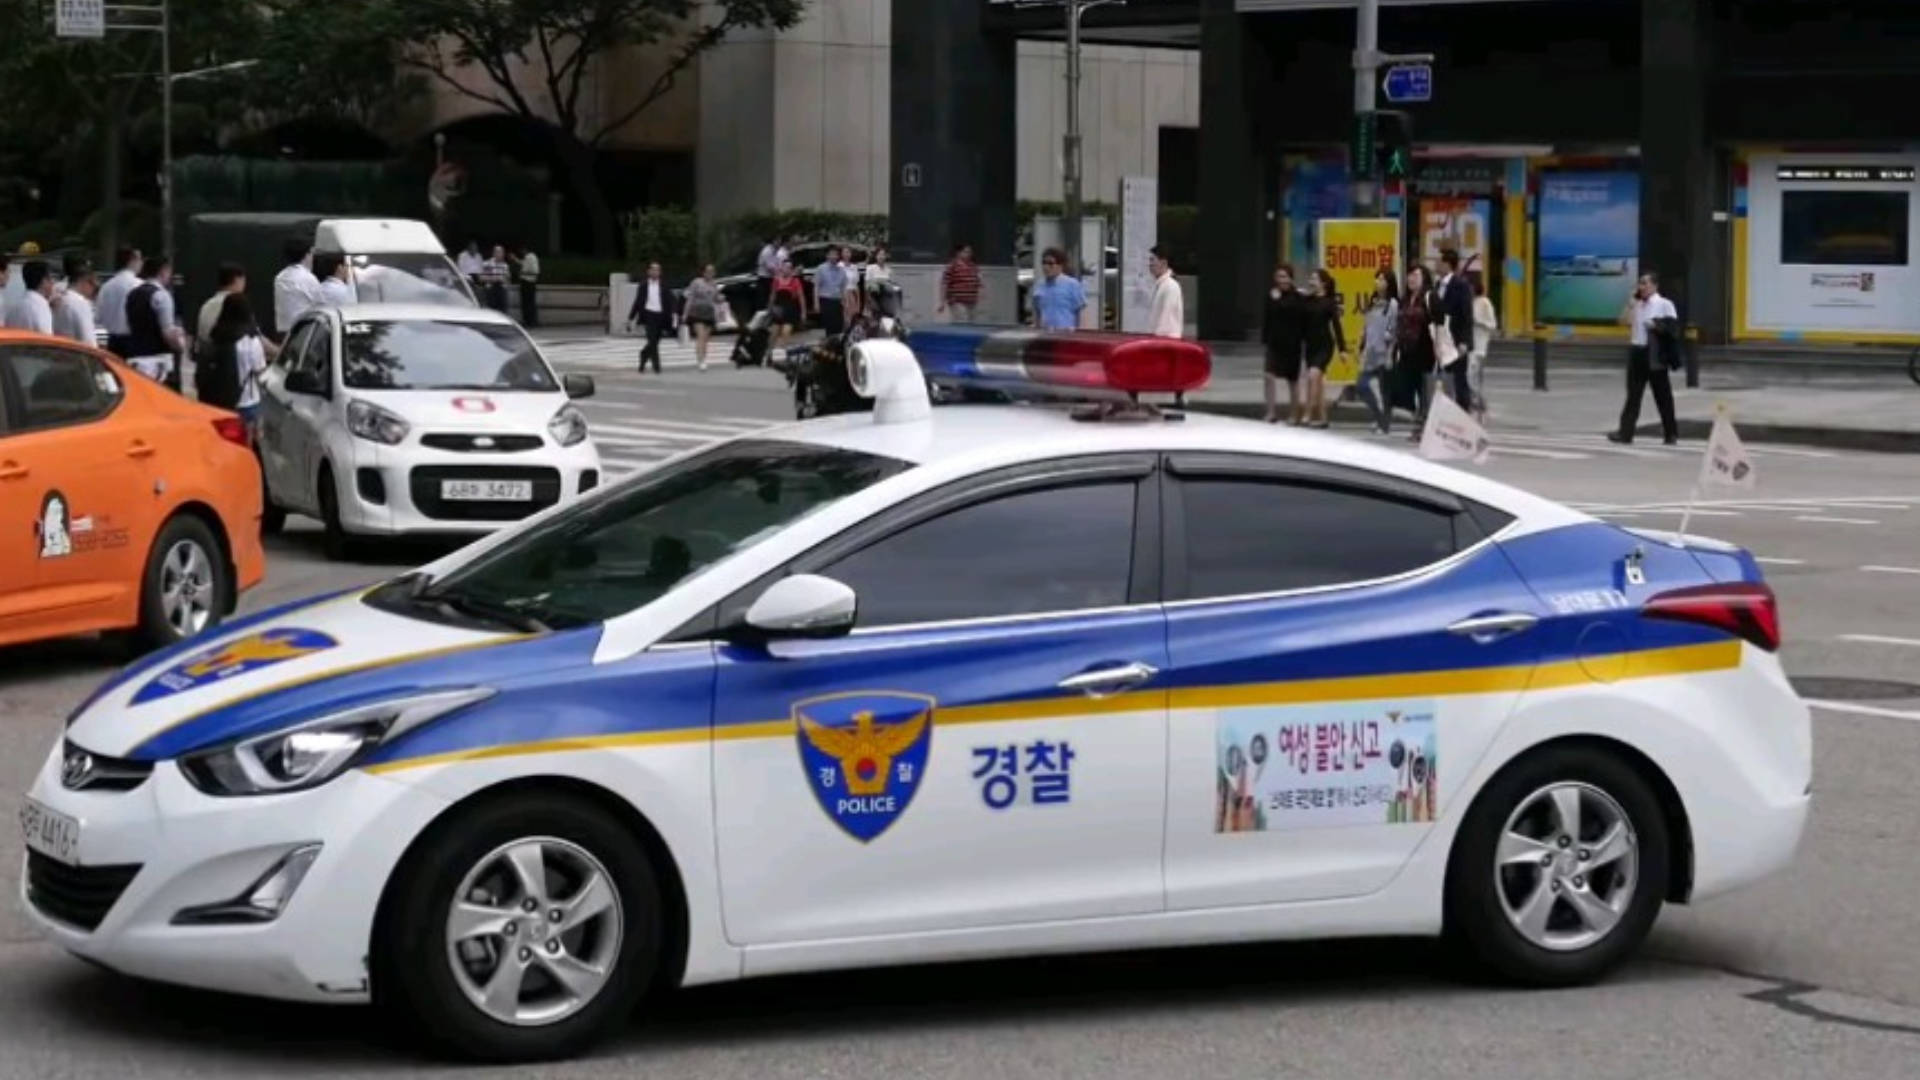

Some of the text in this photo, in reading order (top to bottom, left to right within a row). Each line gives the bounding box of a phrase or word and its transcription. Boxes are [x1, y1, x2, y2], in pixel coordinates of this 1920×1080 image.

[1279, 723, 1310, 774] 여성
[1351, 719, 1382, 770] 신고
[971, 740, 1076, 811] 경찰
[837, 796, 897, 815] POLICE
